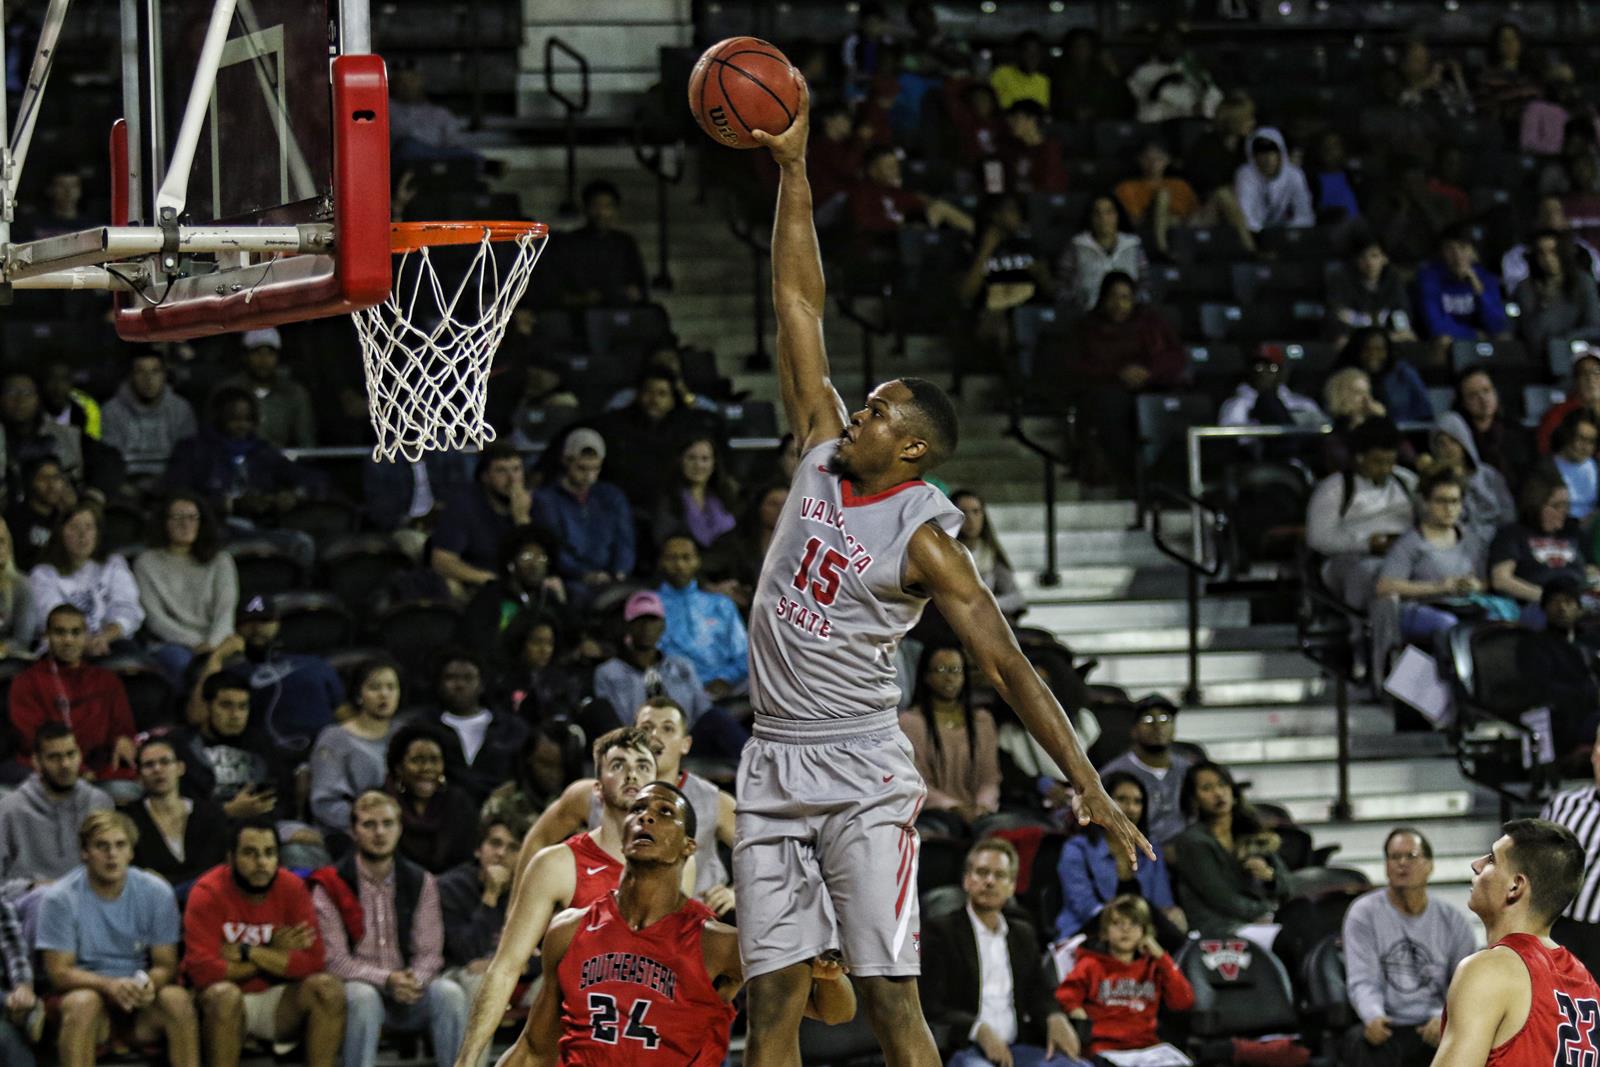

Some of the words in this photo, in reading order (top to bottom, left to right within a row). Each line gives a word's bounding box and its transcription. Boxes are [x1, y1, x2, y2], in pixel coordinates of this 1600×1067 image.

[791, 535, 851, 608] 15
[776, 596, 832, 640] STATE
[579, 952, 677, 1002] SOUTHEASTERN
[587, 992, 661, 1050] 24
